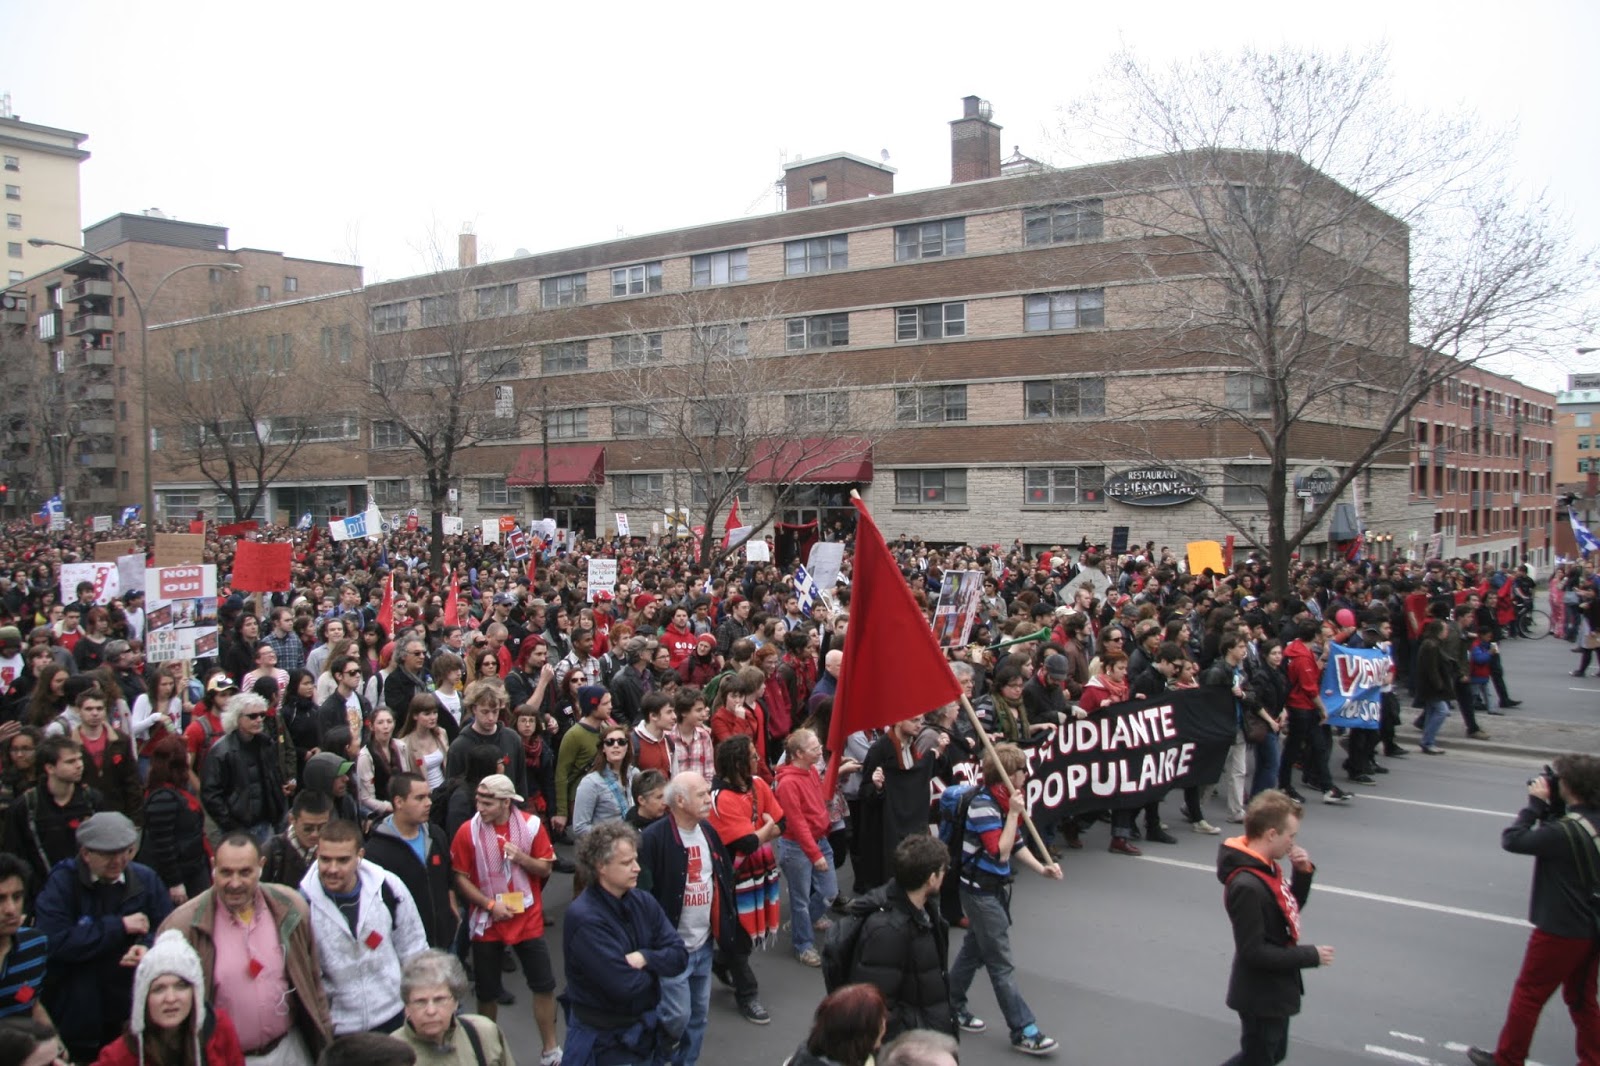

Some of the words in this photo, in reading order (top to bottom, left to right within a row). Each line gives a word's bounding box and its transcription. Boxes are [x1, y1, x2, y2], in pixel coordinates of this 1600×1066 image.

[1128, 470, 1177, 480] RESTAURANT
[1109, 483, 1121, 495] LE
[163, 568, 199, 579] NON
[163, 582, 200, 592] OUI
[1040, 704, 1177, 762] UDIANTE
[1027, 742, 1197, 818] POPULAIRE
[684, 892, 709, 906] RABLE
